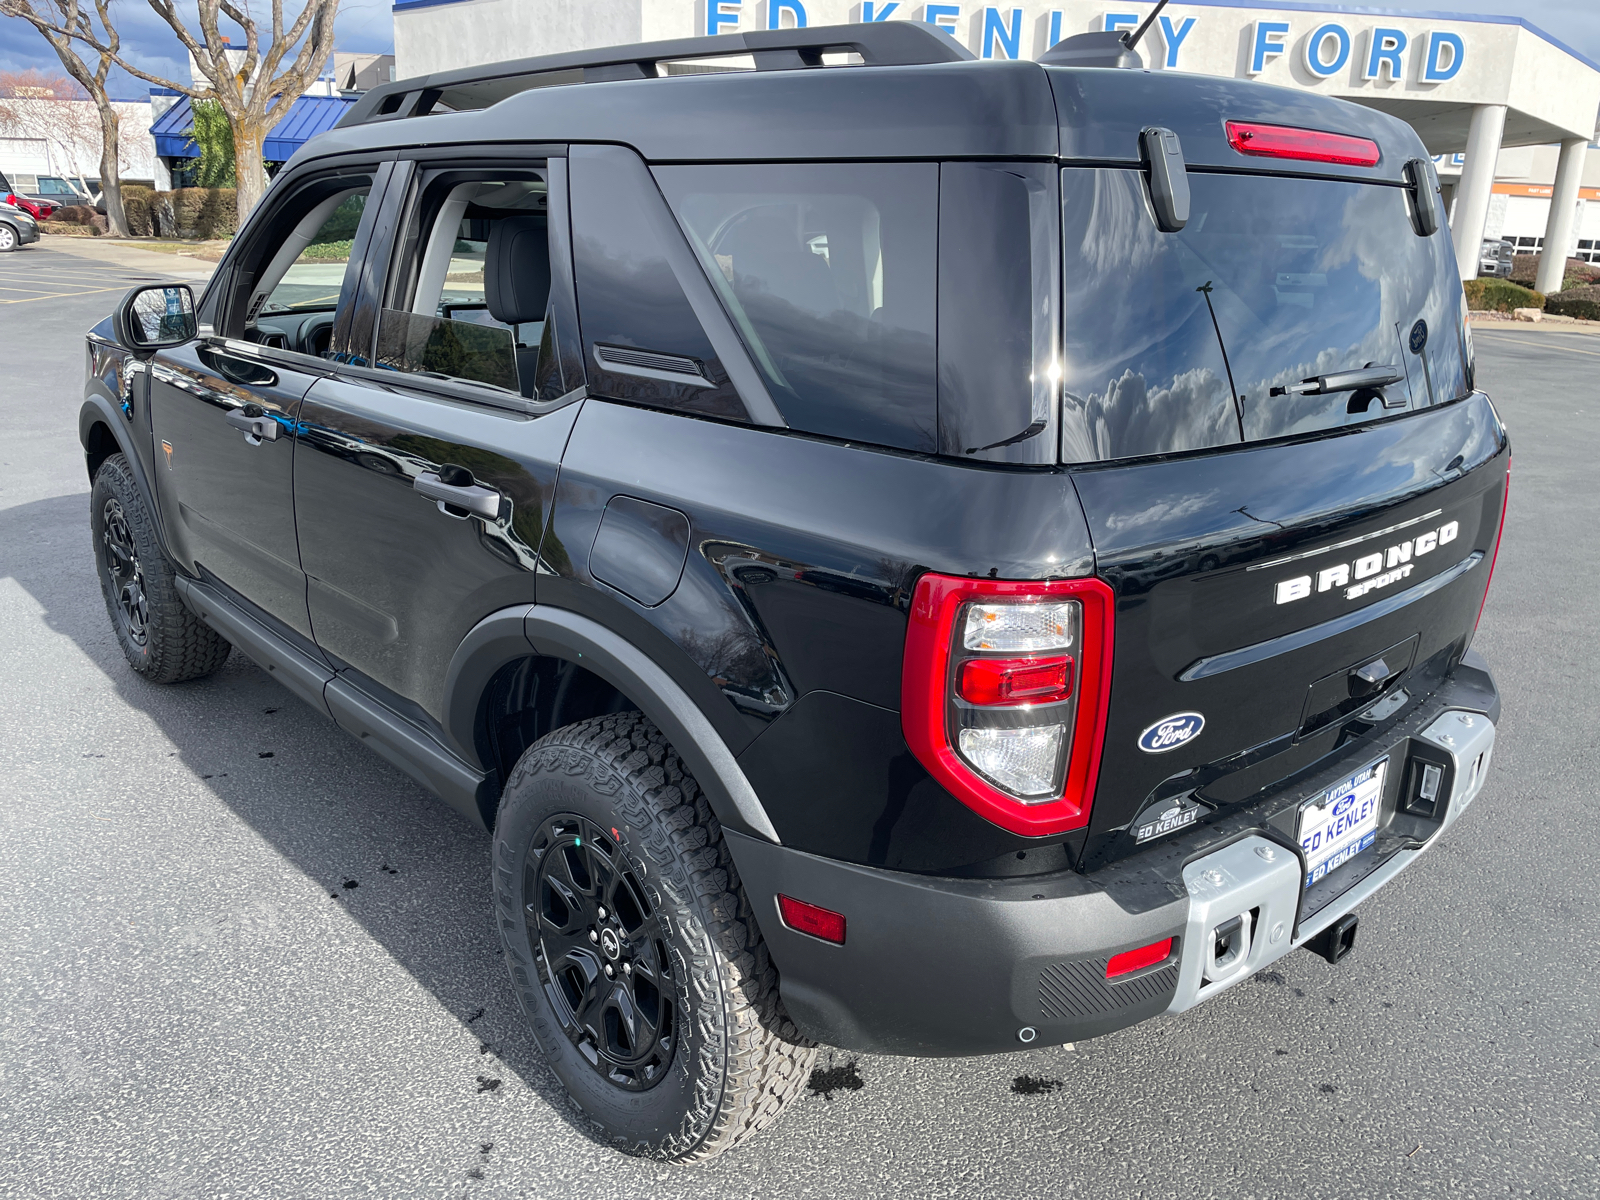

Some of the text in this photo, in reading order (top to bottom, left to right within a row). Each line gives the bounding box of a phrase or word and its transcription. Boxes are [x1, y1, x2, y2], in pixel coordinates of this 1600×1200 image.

[1247, 19, 1466, 84] FORD
[1274, 521, 1459, 605] BRONCO
[1344, 563, 1414, 600] SPORT
[1325, 768, 1372, 804] LAYTON, UTAH
[1138, 808, 1198, 839] ED KENLEY
[1303, 830, 1321, 855] ED
[1326, 795, 1377, 843] KENLEY
[1312, 863, 1326, 883] ED
[1326, 840, 1361, 873] KENLEY
